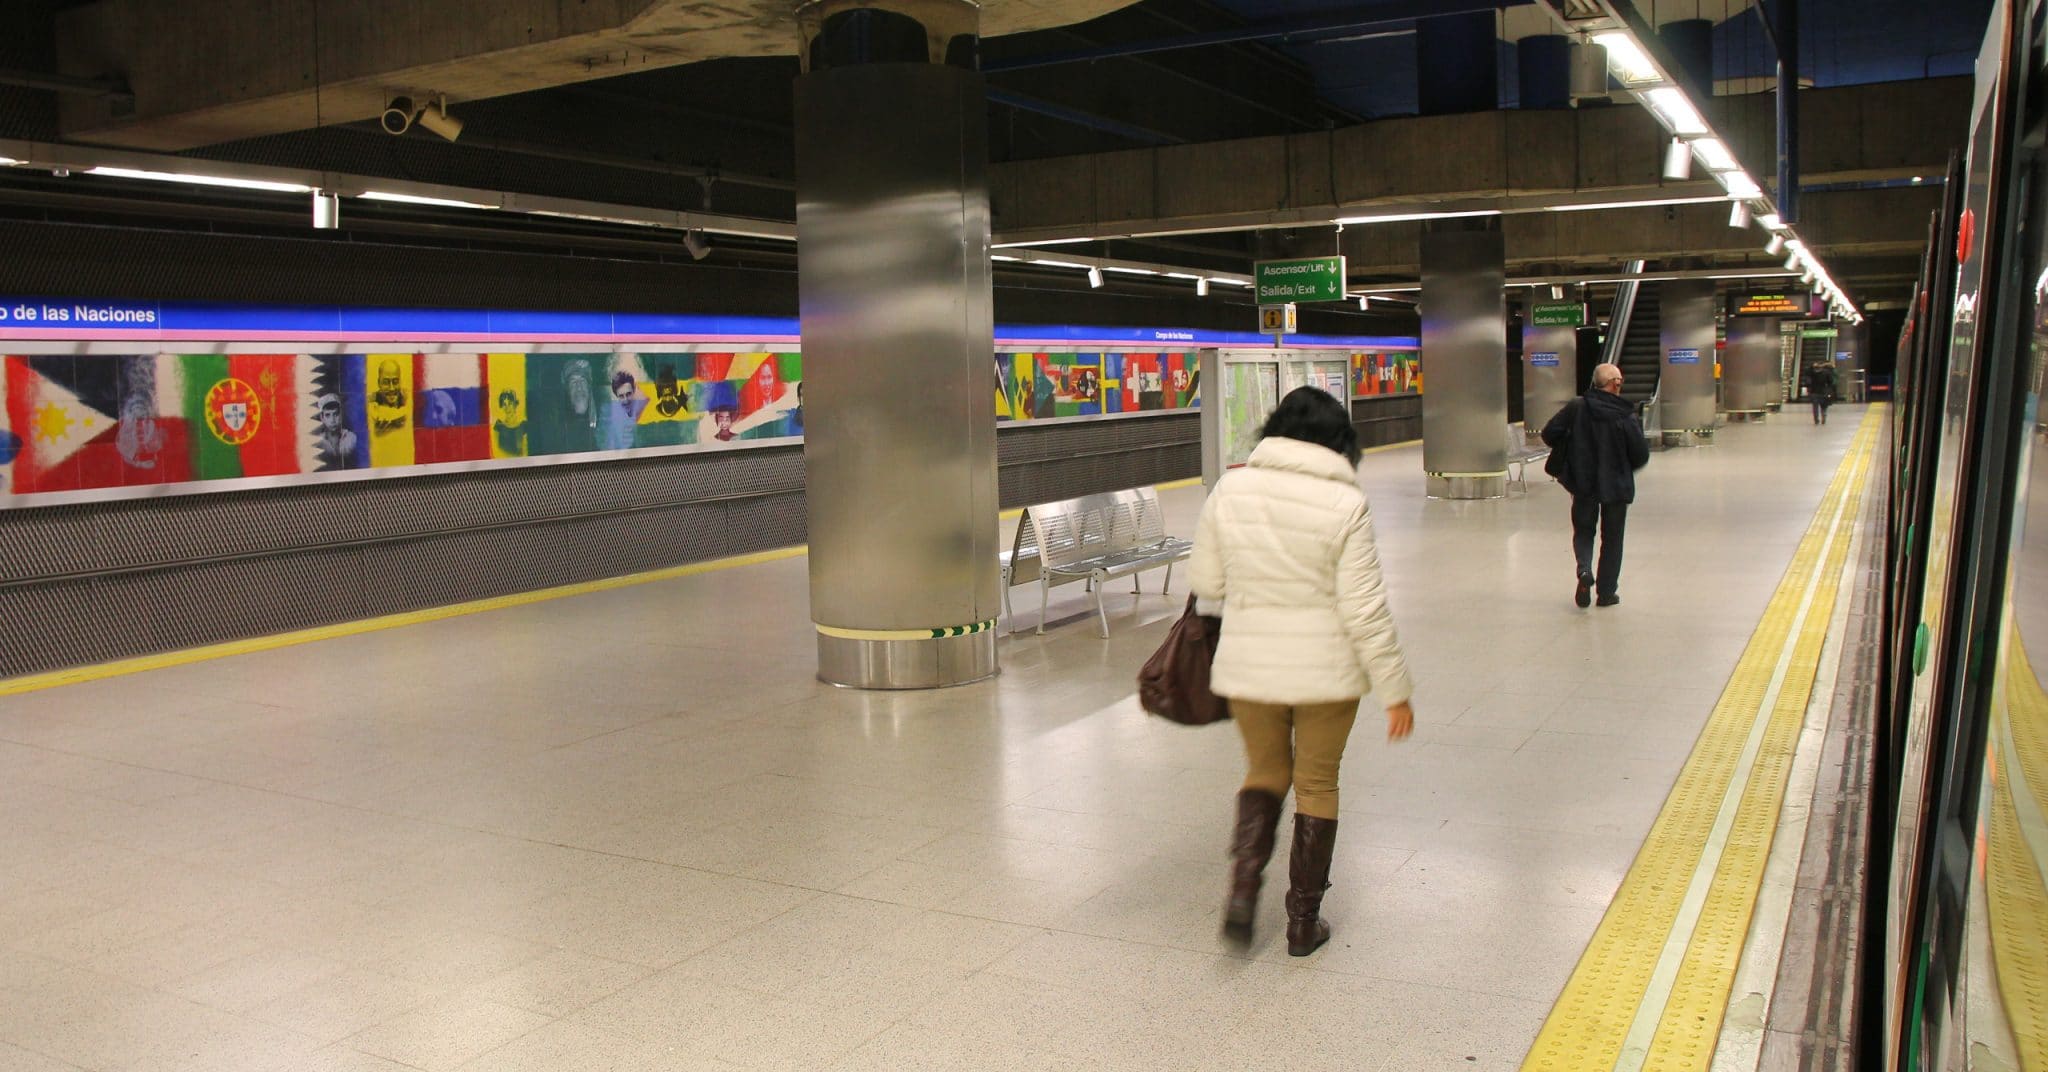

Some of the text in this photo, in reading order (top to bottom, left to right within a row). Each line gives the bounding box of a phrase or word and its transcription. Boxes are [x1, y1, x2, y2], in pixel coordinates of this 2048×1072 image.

[1264, 263, 1324, 276] Ascensor/Lift
[1260, 283, 1316, 297] Salida/Exit
[13, 304, 37, 321] de
[43, 304, 70, 321] las
[75, 305, 156, 323] Naciones
